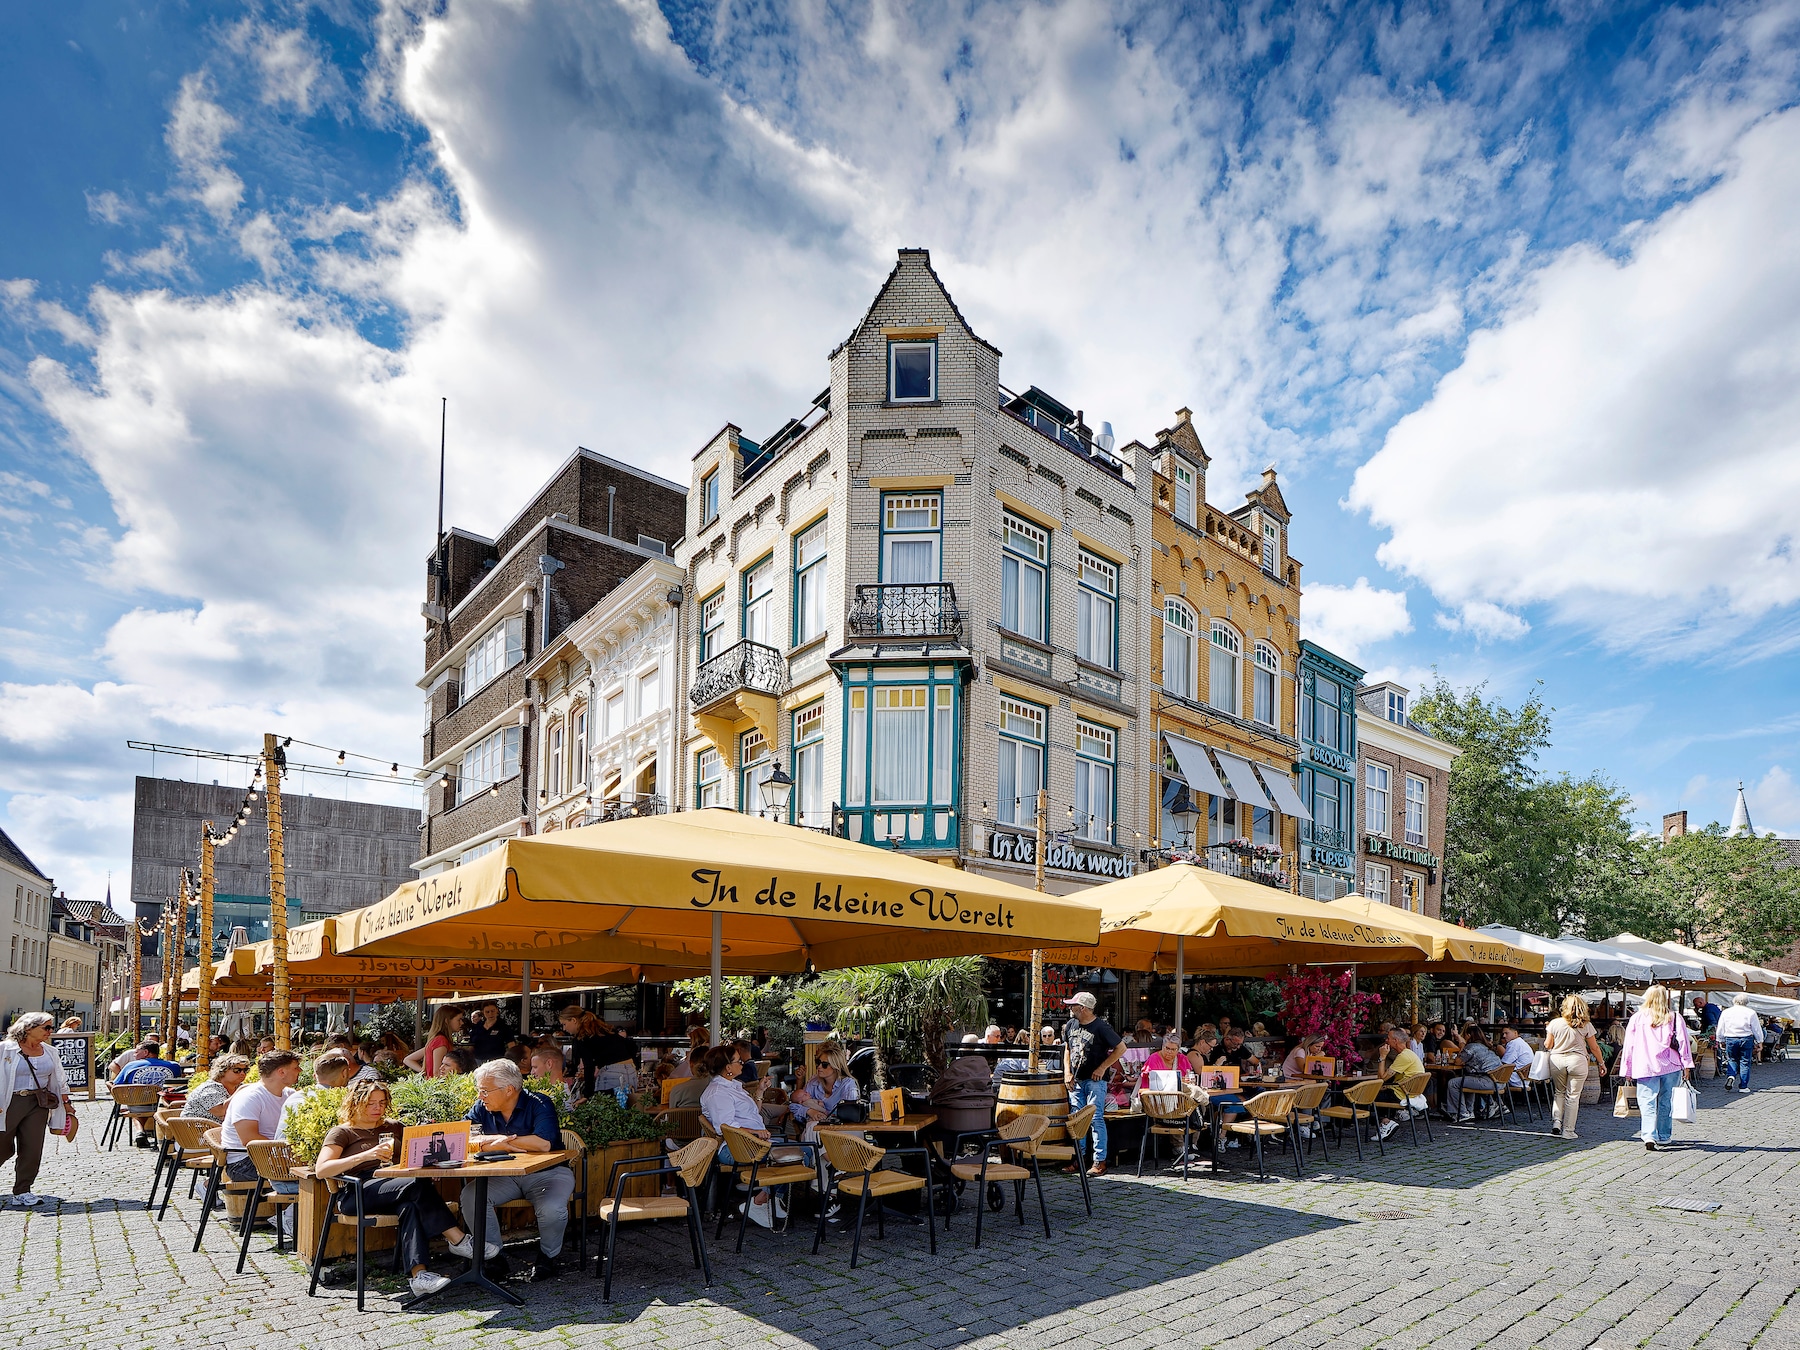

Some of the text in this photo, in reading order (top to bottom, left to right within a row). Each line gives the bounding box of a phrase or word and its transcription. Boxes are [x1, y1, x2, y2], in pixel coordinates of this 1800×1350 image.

[1311, 748, 1351, 772] BROODJE
[993, 833, 1137, 878] In de leine werelt
[1313, 848, 1350, 868] FLIPSEN
[1368, 836, 1440, 868] De Paternoster
[363, 875, 463, 942] In de kleine Werelt
[691, 868, 1014, 928] In de kleine Werelt
[1100, 915, 1138, 929] erelt
[1276, 917, 1404, 944] In de kleine Werelt
[1478, 946, 1486, 960] de
[55, 1039, 86, 1049] 250
